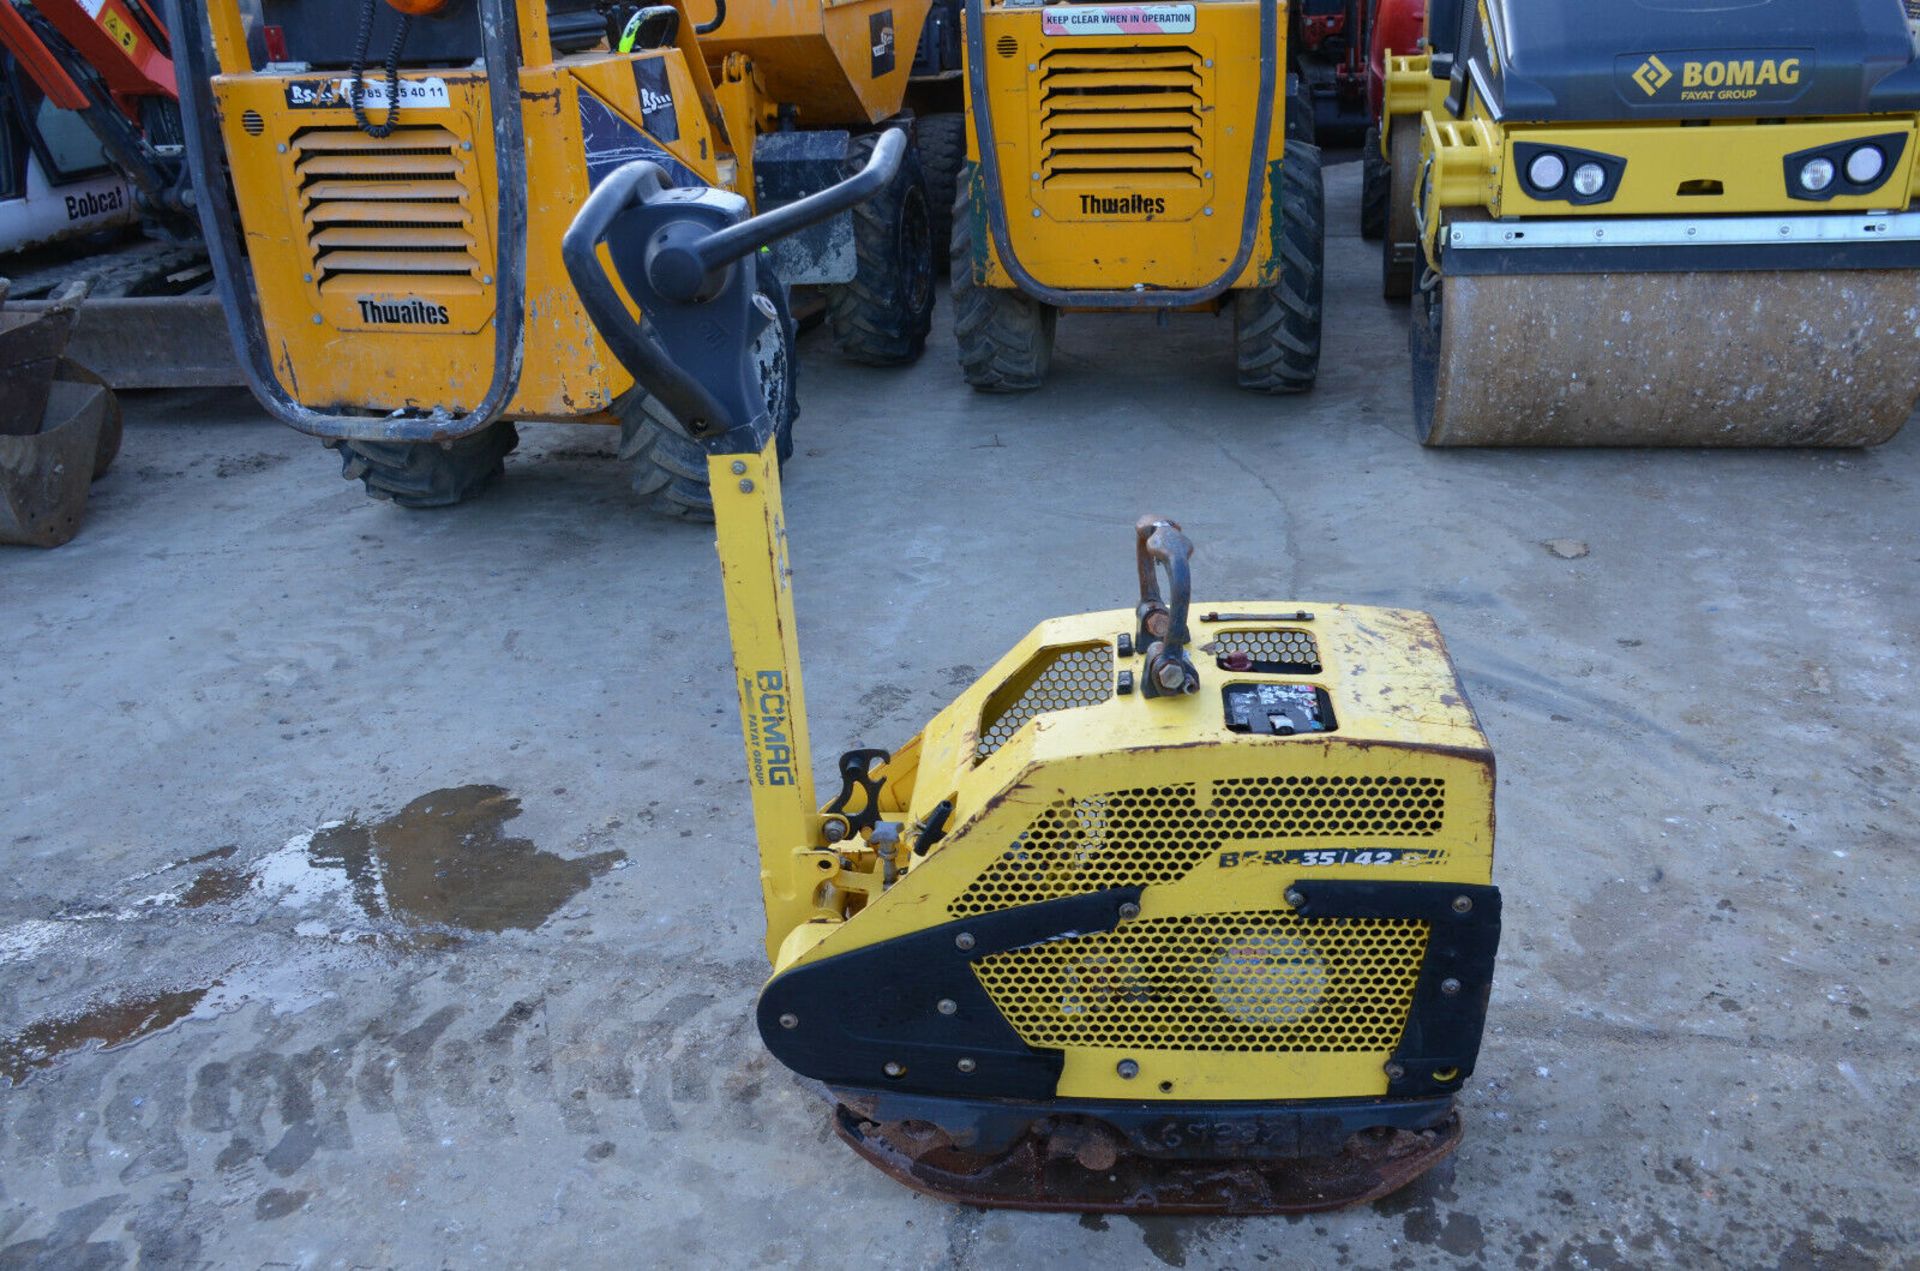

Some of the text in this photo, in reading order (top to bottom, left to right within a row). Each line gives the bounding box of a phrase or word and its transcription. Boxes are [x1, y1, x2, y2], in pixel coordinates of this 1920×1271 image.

[1047, 13, 1191, 25] KEEP CLEAR WHEN IN OPERATION
[1682, 58, 1801, 87] BOMAG
[411, 87, 426, 97] 40
[429, 87, 444, 97] 11
[1681, 89, 1758, 101] FAYAT GROUP
[64, 186, 124, 221] Bobcat
[1079, 194, 1165, 214] Thwaites
[357, 300, 450, 325] Thwaites
[748, 714, 765, 786] FAYAT GROUP
